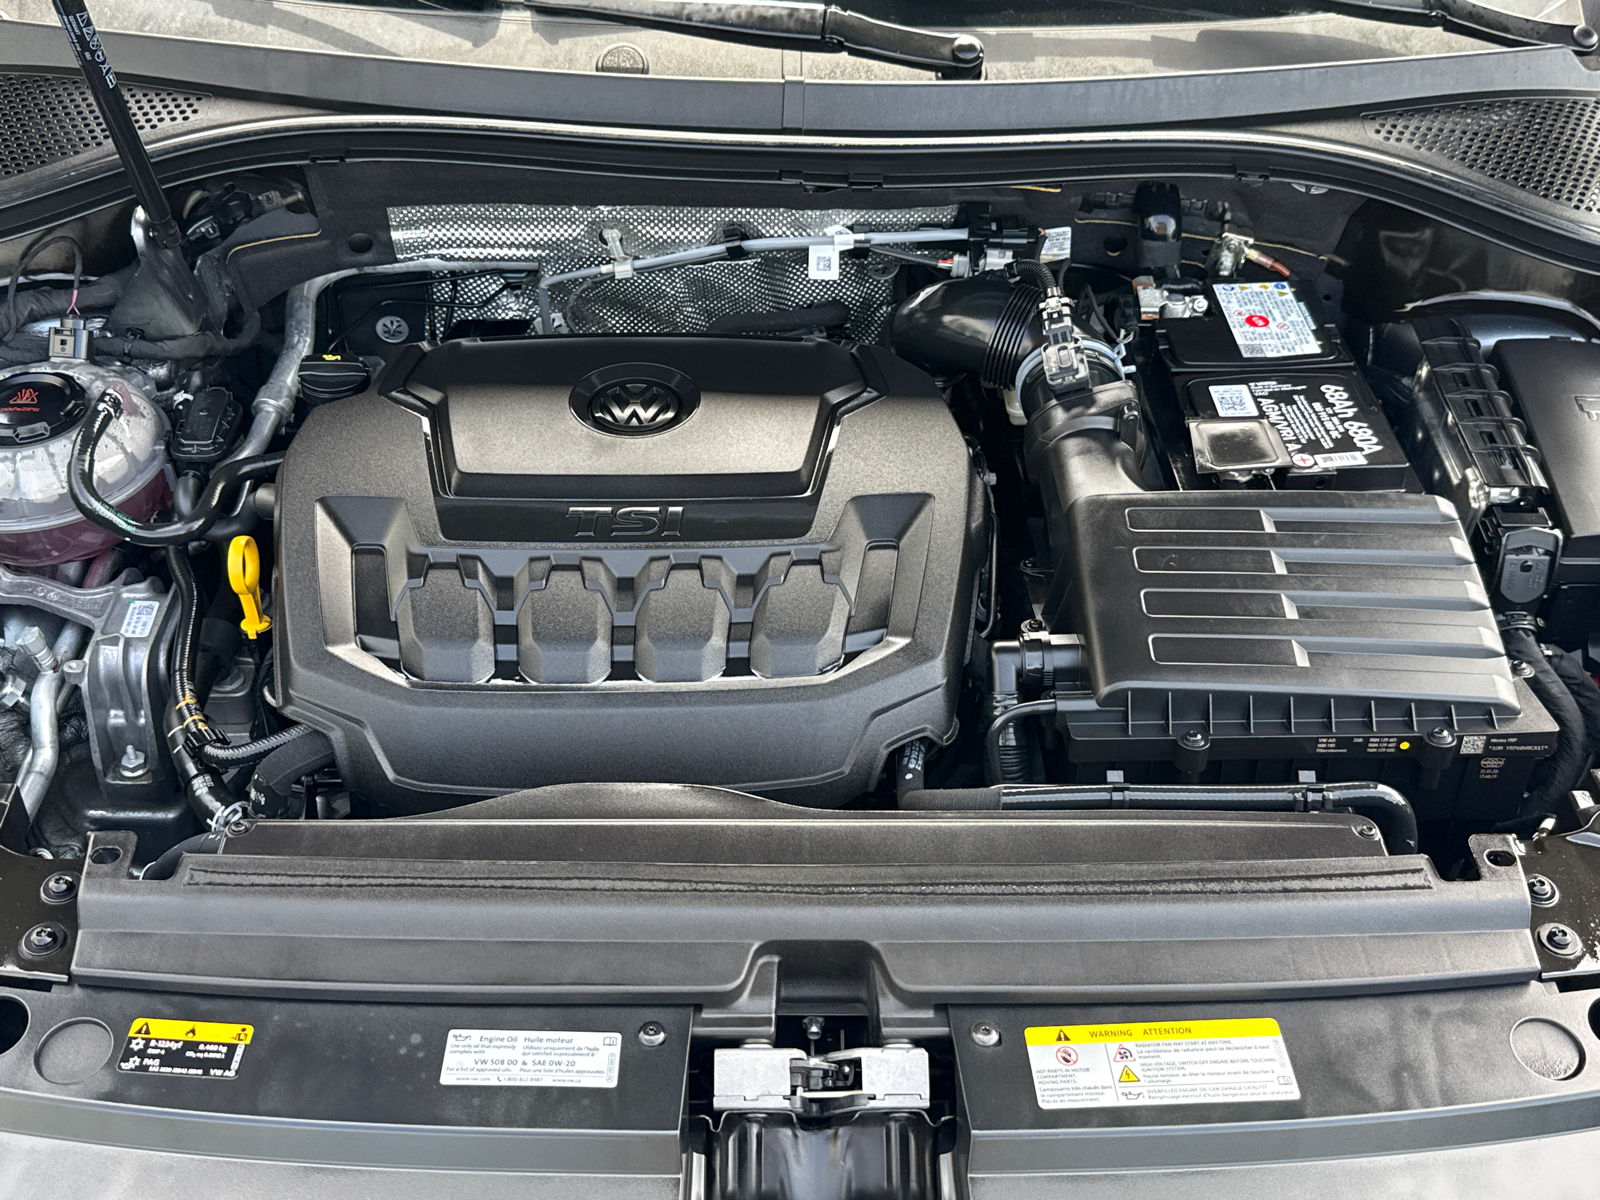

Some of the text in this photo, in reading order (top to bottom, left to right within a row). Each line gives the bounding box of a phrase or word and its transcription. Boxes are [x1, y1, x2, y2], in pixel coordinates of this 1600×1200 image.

[1320, 384, 1384, 455] 68Ah 680A
[566, 506, 684, 537] TSI
[1089, 1026, 1192, 1039] WARNING ATTENTION
[150, 1040, 183, 1050] R-1234yf
[219, 1044, 227, 1052] kg
